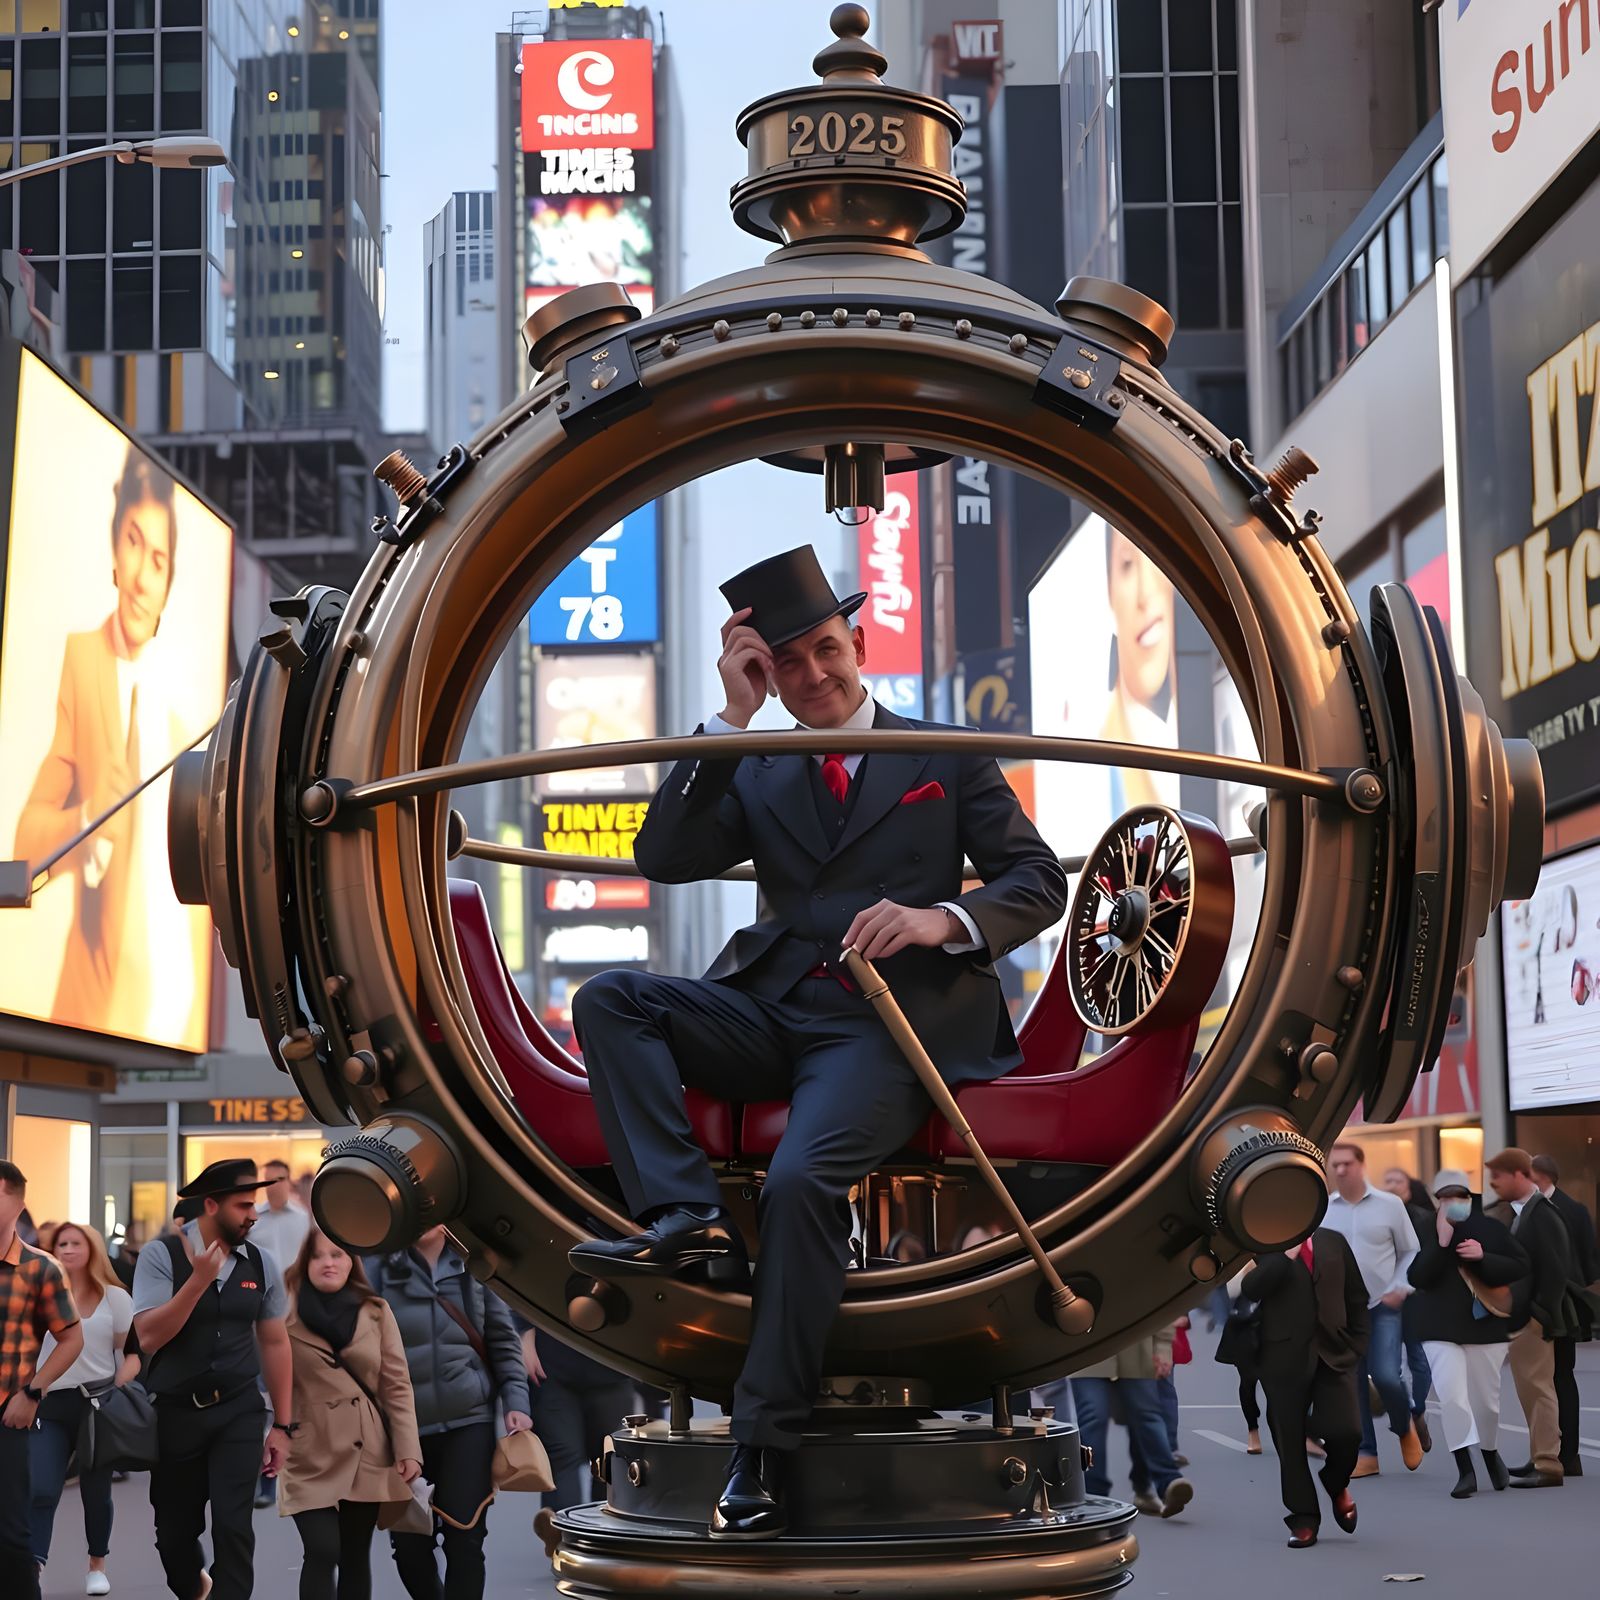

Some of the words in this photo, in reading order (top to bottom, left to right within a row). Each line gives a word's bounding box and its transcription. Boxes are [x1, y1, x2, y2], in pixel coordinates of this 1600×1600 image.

[790, 111, 906, 155] 2025
[540, 147, 635, 172] TIMES
[559, 594, 624, 640] 78
